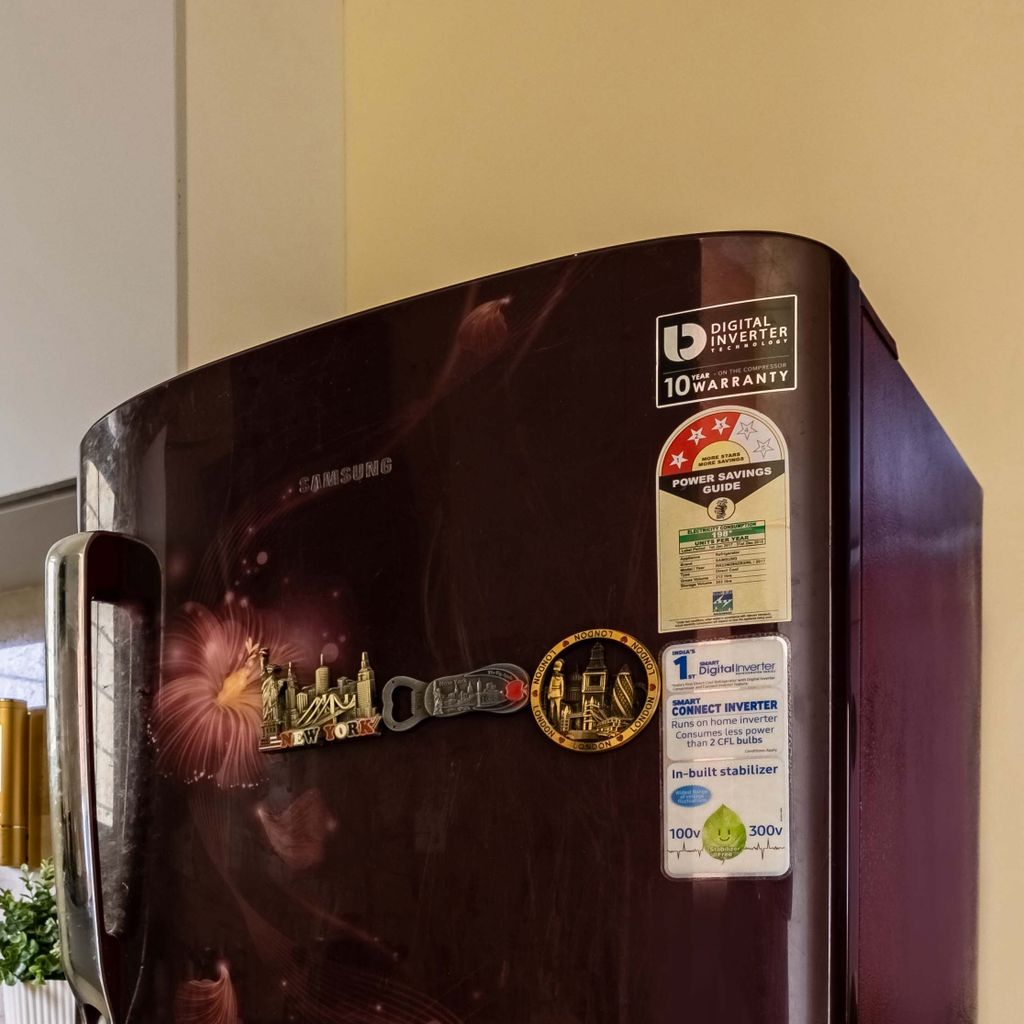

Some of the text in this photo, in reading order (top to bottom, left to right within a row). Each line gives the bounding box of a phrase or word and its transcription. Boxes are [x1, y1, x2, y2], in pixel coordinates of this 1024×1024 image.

[711, 316, 771, 334] DIGITAL
[711, 326, 787, 346] INVERTER
[711, 339, 787, 353] TECHNOLOGY
[692, 372, 710, 381] YEAR
[729, 366, 741, 374] THE
[743, 363, 787, 373] COMPRESSOR
[664, 375, 690, 398] 10
[693, 370, 789, 393] WARRANTY
[299, 457, 393, 493] SAMSUNG
[672, 467, 772, 488] POWER SAVINGS
[703, 482, 741, 494] GUIDE
[574, 630, 614, 642] LONDON
[534, 650, 556, 685] LONDON
[630, 642, 656, 676] LONDON
[672, 698, 700, 706] SMART
[672, 700, 778, 716] CONNECT INVERTER
[533, 705, 556, 738] LONDON
[630, 696, 655, 732] LONDON
[672, 720, 694, 728] Runs
[711, 717, 737, 726] home
[740, 715, 778, 724] inverter
[280, 719, 377, 748] NEW YORK
[676, 726, 775, 739] Consumes less power
[573, 740, 612, 750] LONDON
[687, 735, 762, 748] than 2 CFL bulbs
[672, 765, 778, 779] In-built stabilizer
[670, 828, 700, 839] 100v
[749, 824, 783, 836] 300v
